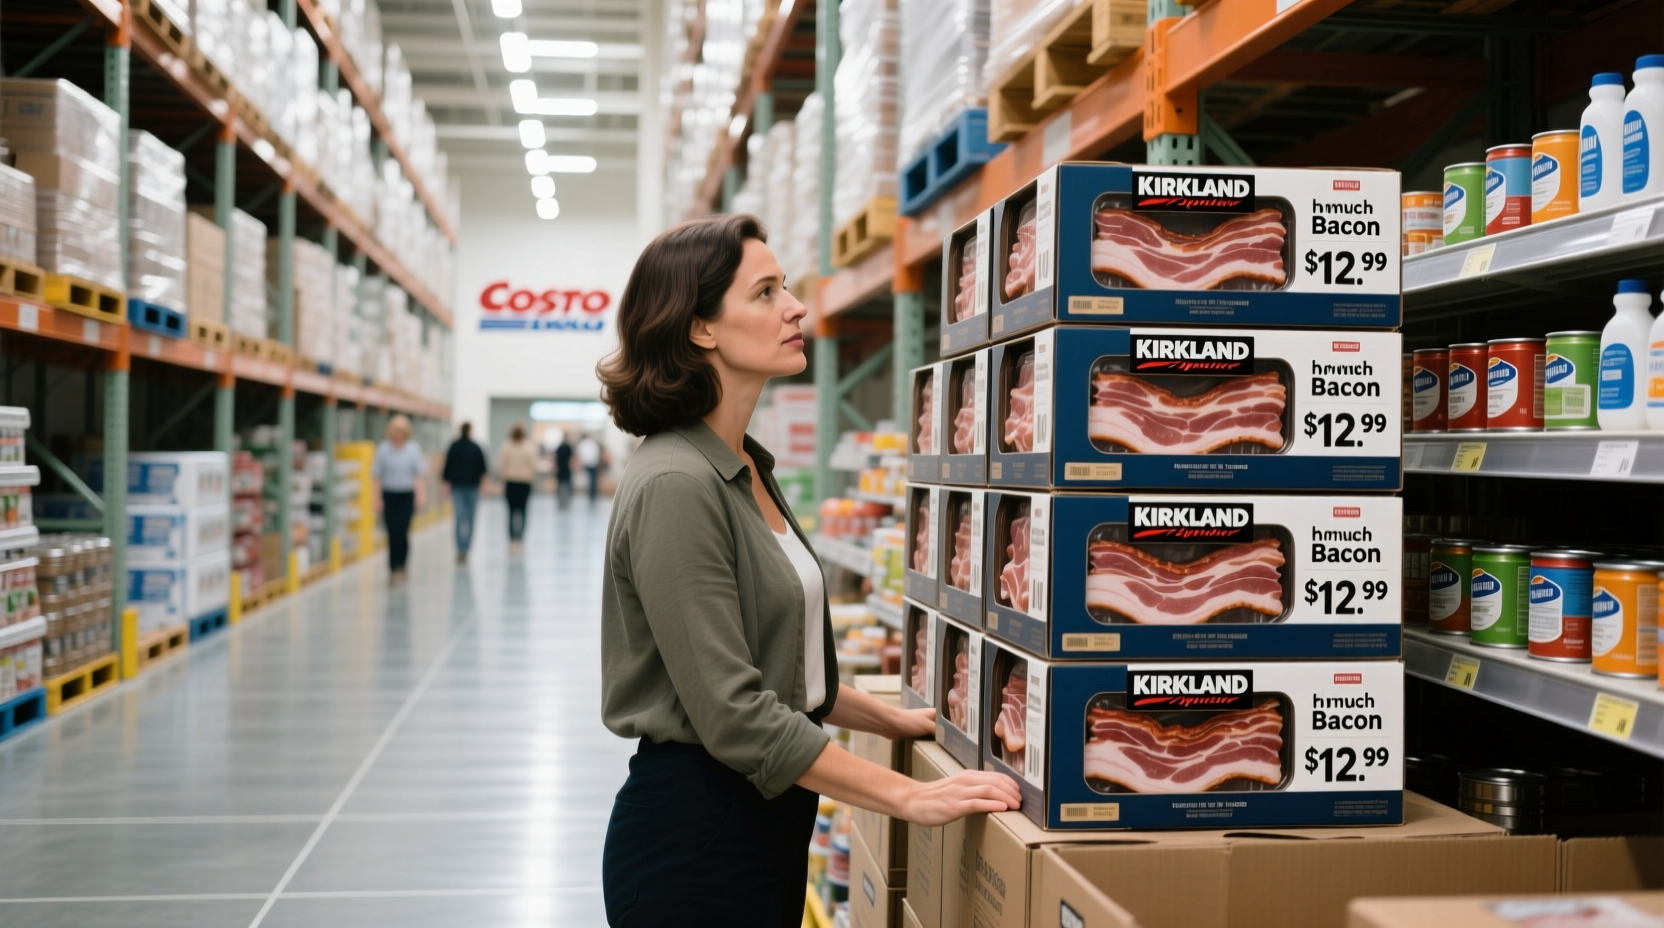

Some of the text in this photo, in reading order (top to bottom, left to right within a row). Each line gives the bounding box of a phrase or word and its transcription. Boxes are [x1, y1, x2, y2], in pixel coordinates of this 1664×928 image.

[1138, 176, 1250, 198] KIRKLAND
[1312, 215, 1380, 236] Bacon
[1304, 248, 1388, 286] $12.99
[1137, 339, 1250, 361] KIRKLAND
[1312, 377, 1380, 397] Bacon
[1304, 411, 1387, 448] $12.99
[1134, 506, 1250, 528] KIRKLAND
[1312, 543, 1381, 563] Bacon
[1304, 578, 1388, 615] $12.99
[1133, 674, 1249, 695] KIRKLAND
[1312, 710, 1382, 731] Bacon
[1304, 745, 1390, 783] $12.99
